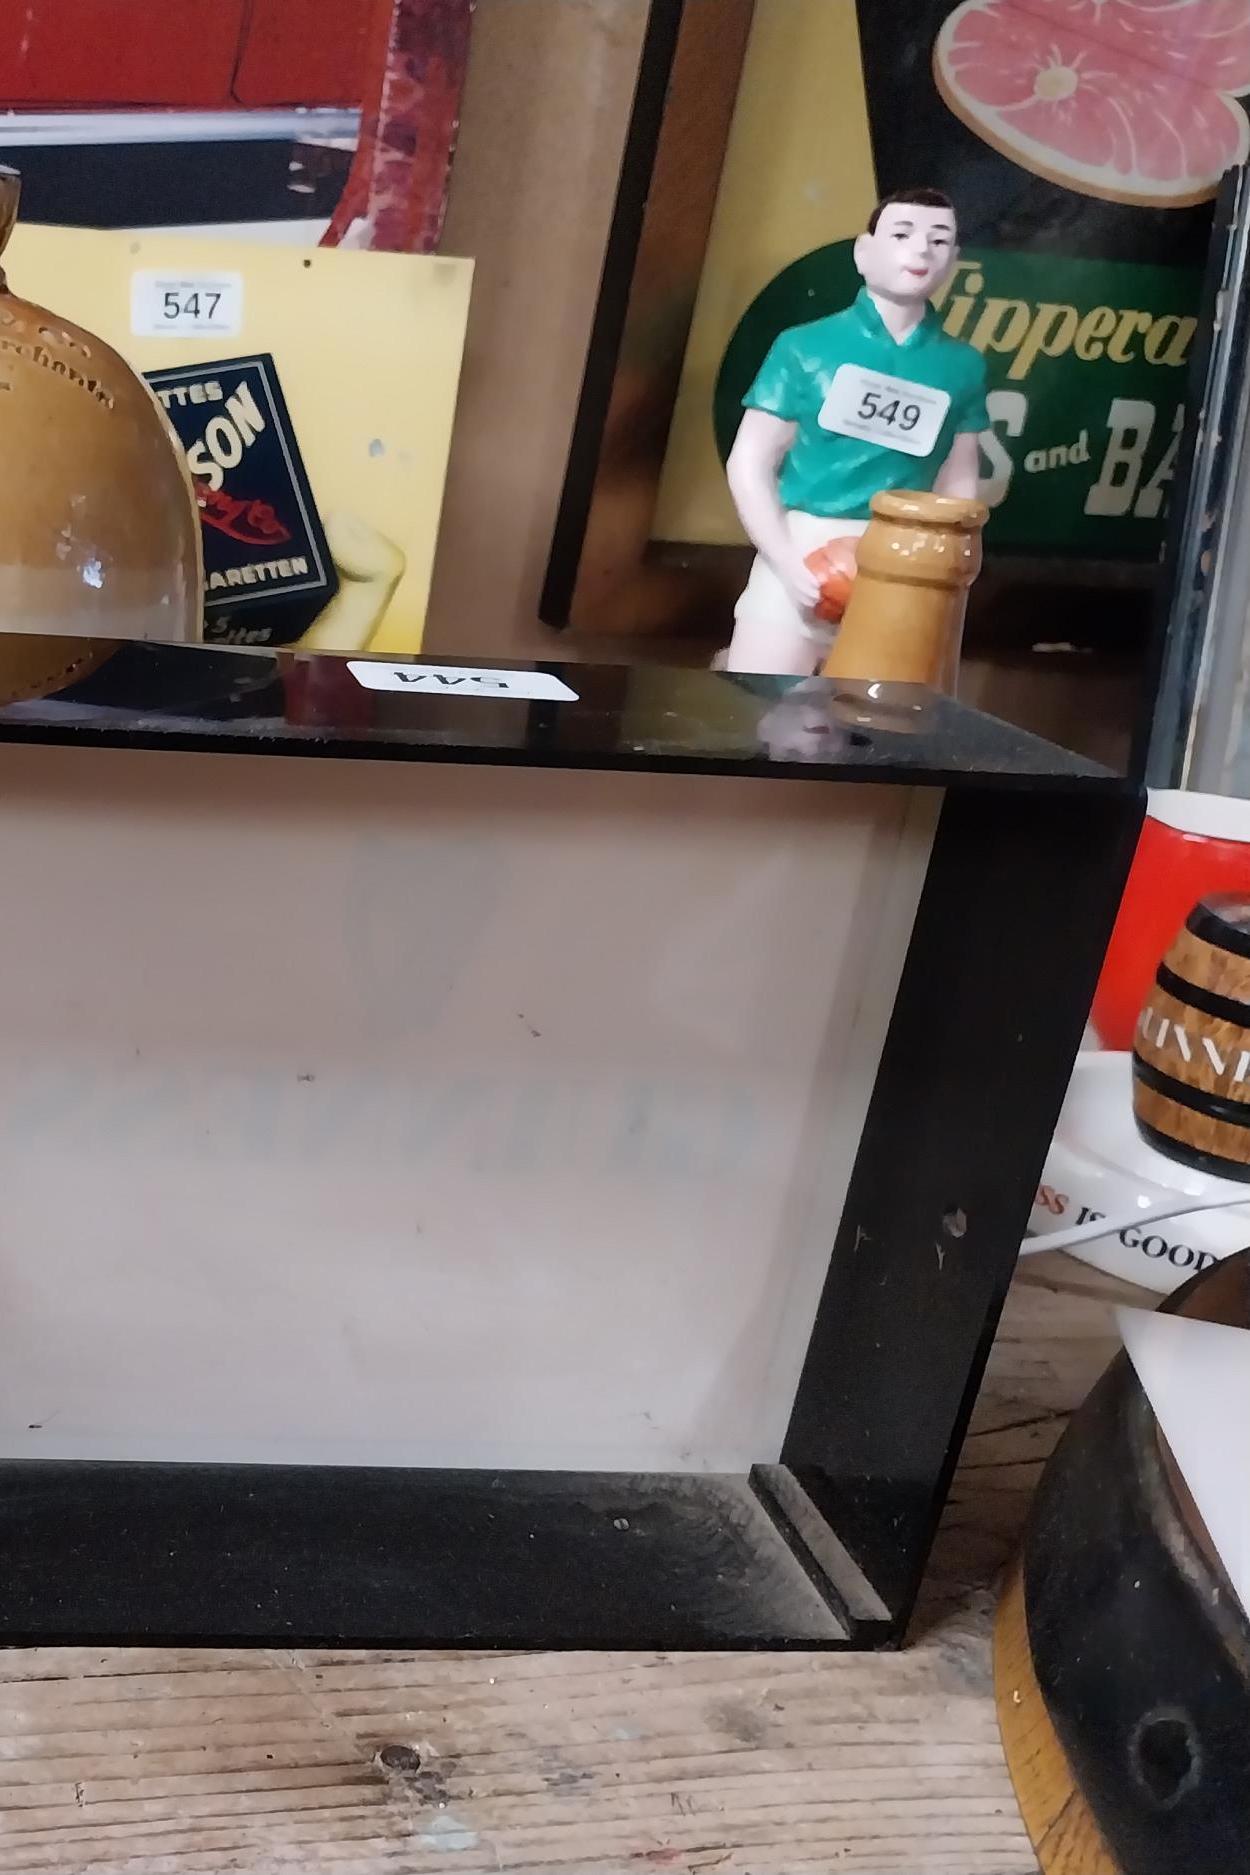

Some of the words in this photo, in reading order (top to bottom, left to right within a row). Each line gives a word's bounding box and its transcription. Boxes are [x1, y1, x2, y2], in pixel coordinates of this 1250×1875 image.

[163, 292, 222, 320] 547
[857, 391, 922, 432] 549
[186, 380, 266, 492] SON
[1023, 428, 1091, 474] and
[203, 555, 309, 591] ARETTEN
